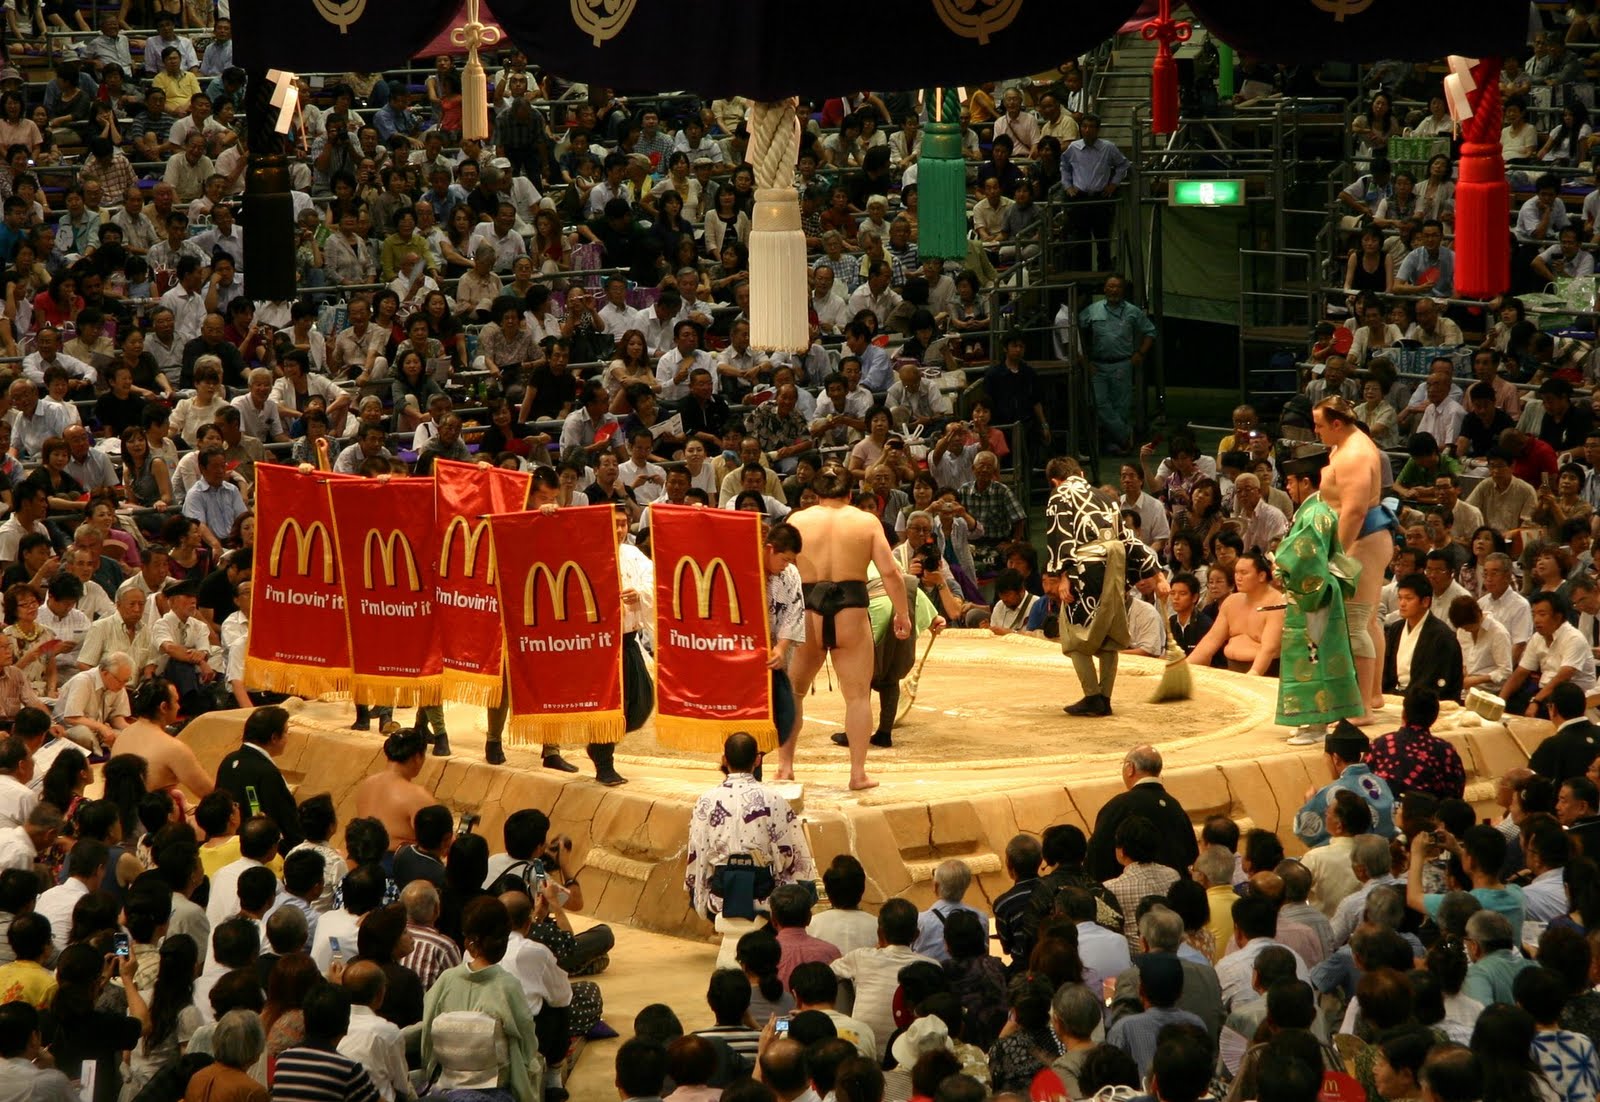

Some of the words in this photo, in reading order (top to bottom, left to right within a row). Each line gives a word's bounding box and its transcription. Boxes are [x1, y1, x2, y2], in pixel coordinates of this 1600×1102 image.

[270, 517, 334, 584] M
[363, 528, 420, 591] M
[439, 515, 494, 585] M
[265, 585, 286, 602] i'm
[287, 588, 330, 609] lovin'
[331, 593, 345, 611] it
[361, 600, 380, 616] i'm
[381, 601, 418, 618] lovin'
[420, 600, 431, 616] it
[435, 586, 452, 606] i'm
[453, 590, 487, 612] lovin'
[487, 595, 498, 614] it
[523, 560, 598, 626] M
[672, 554, 740, 625] M
[520, 637, 547, 653] i'm
[548, 634, 597, 653] lovin'
[598, 632, 611, 648] it
[670, 629, 690, 650] i'm
[690, 632, 738, 653] lovin'
[741, 635, 754, 651] it
